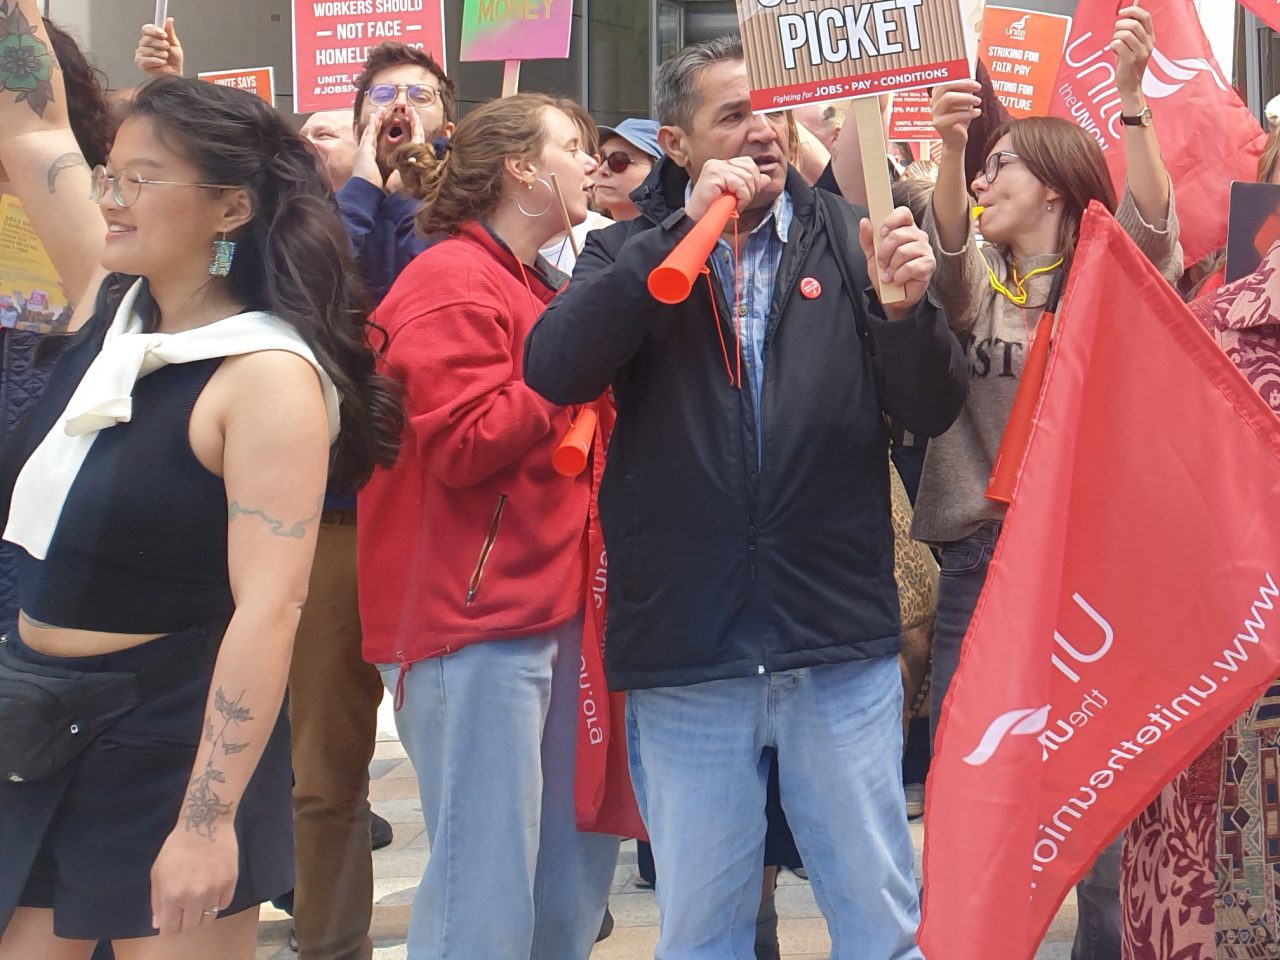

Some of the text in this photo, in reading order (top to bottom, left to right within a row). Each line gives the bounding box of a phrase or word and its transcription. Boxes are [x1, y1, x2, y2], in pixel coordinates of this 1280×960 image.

[313, 0, 373, 17] WORKERS
[336, 19, 403, 40] NOT FACE
[988, 46, 1040, 63] STRIKING FOR
[991, 61, 1031, 76] FAIR PAY
[237, 75, 257, 88] SAYS
[317, 75, 352, 86] UNITE,
[772, 68, 949, 104] Fighting for JOBS PAY CONDITIONS
[1017, 83, 1034, 96] FOR
